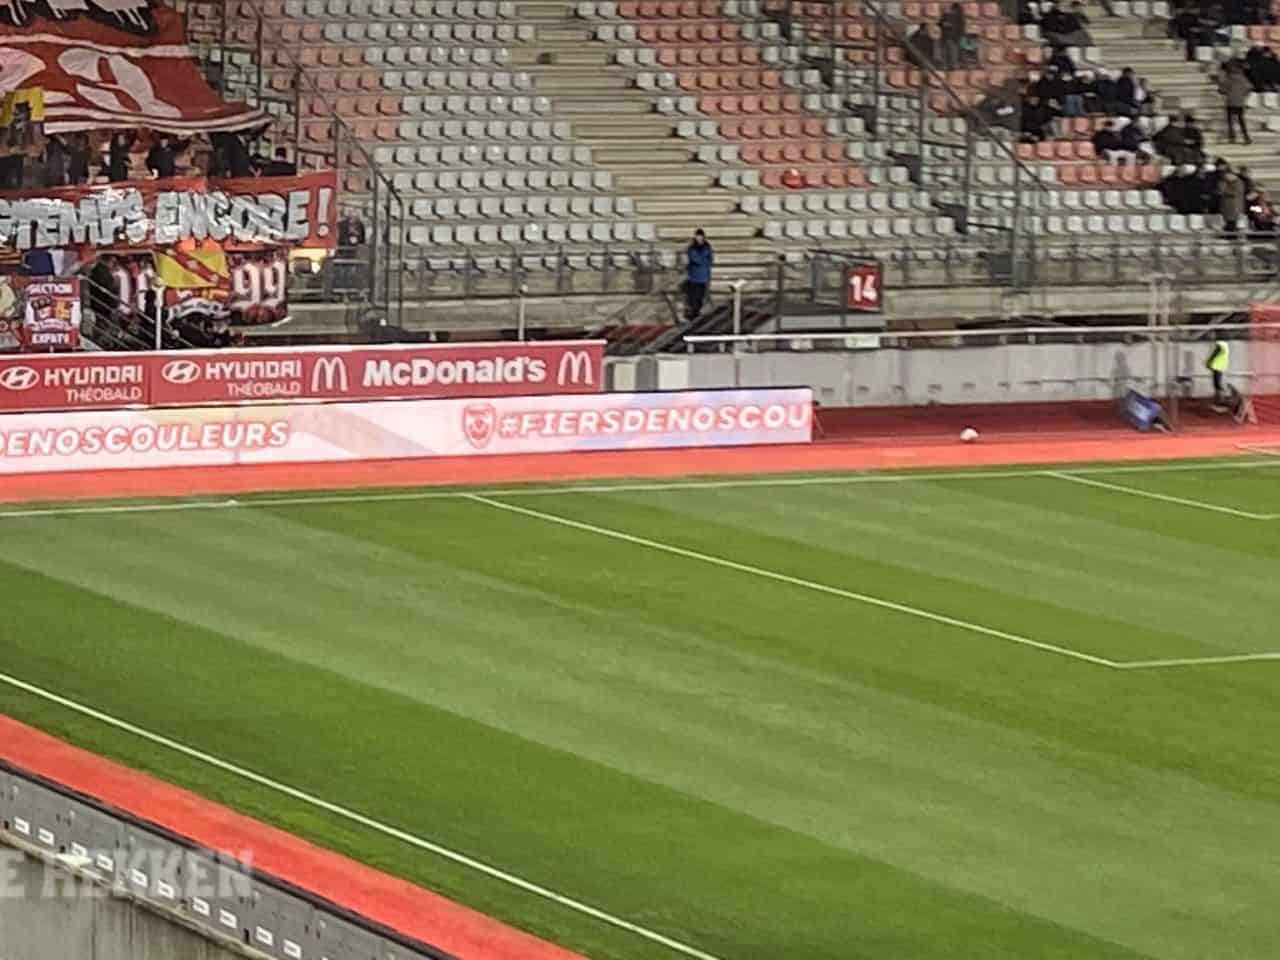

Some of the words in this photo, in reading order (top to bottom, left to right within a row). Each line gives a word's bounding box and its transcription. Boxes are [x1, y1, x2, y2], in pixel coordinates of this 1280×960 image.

[849, 275, 877, 302] 14
[45, 365, 143, 385] HYUNDAI
[205, 359, 301, 380] HYUNDAI
[363, 355, 546, 387] McDonald's
[66, 386, 142, 403] THÉOBALD
[227, 379, 300, 397] THÉOBALD
[499, 403, 811, 436] #FIERSDENOSCOU
